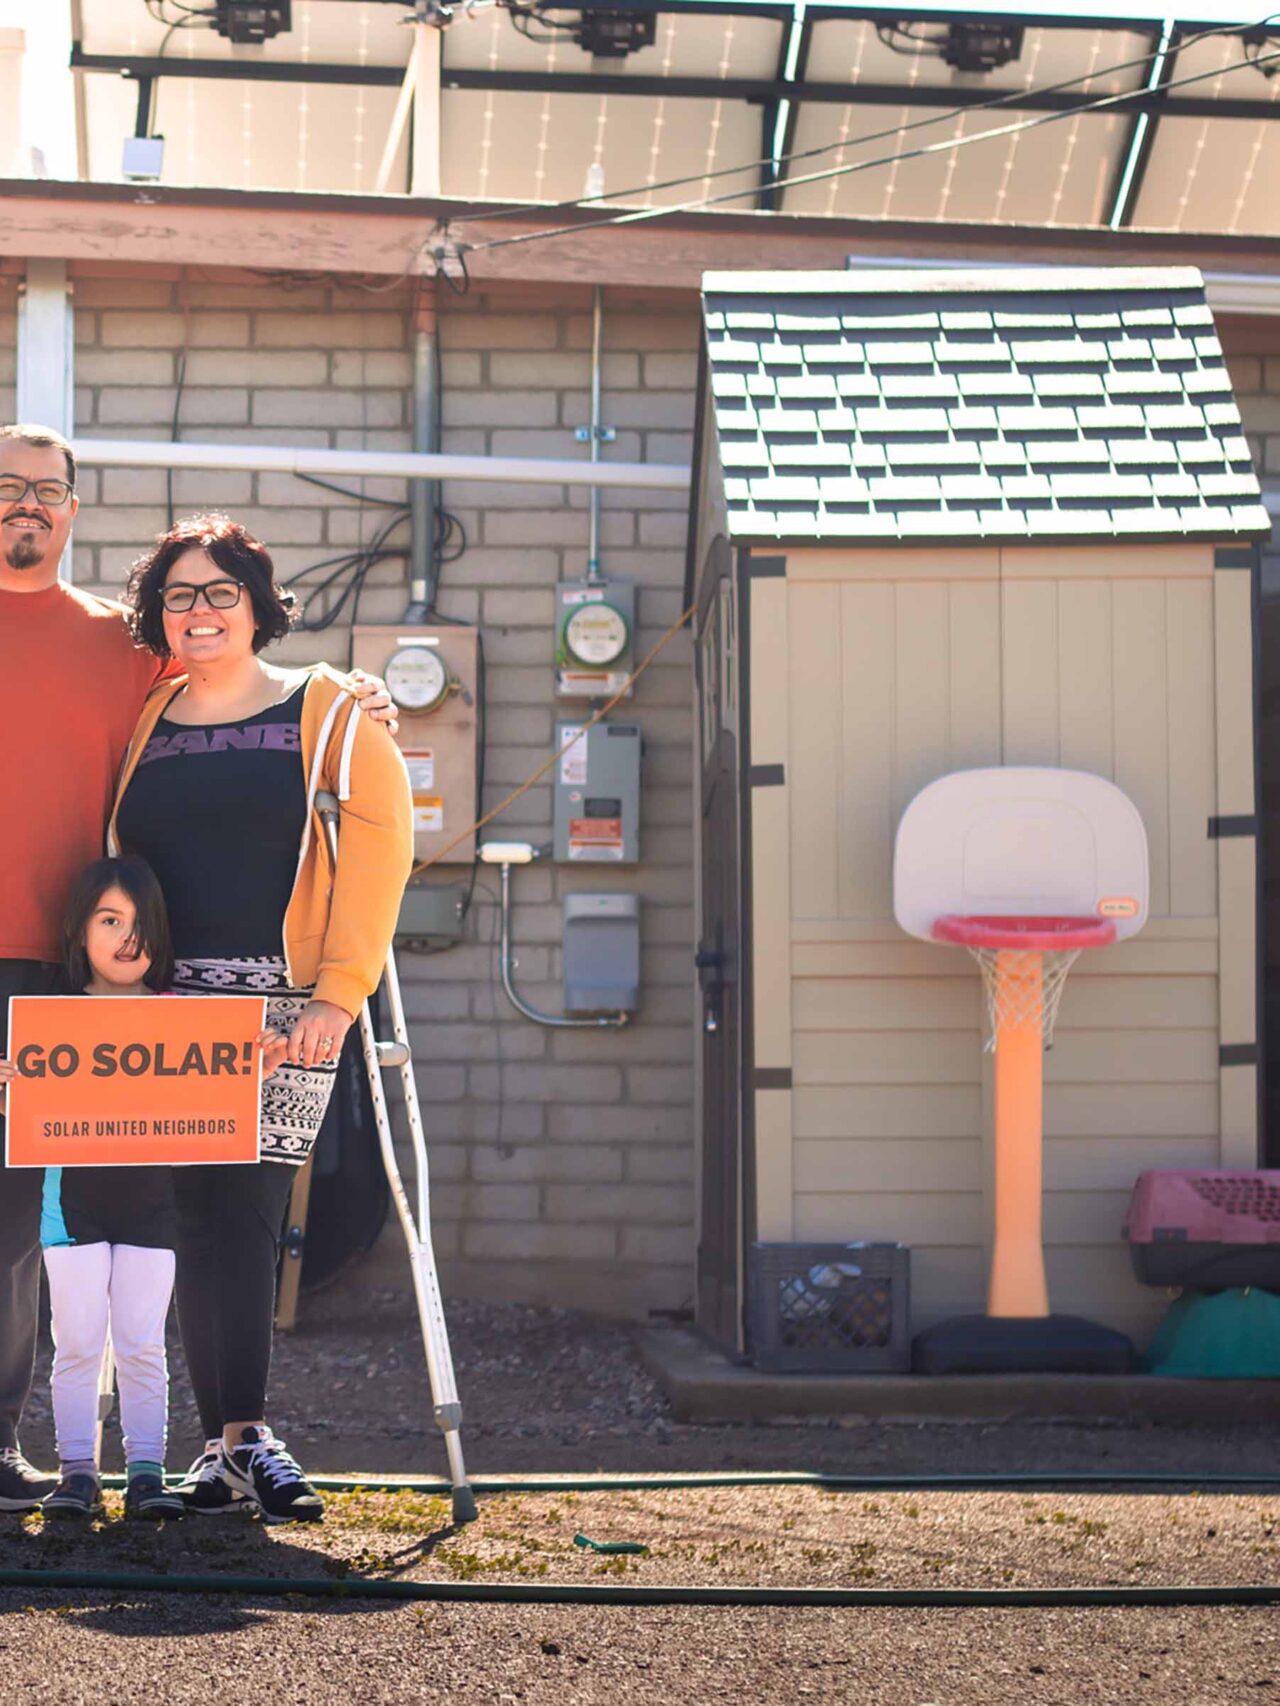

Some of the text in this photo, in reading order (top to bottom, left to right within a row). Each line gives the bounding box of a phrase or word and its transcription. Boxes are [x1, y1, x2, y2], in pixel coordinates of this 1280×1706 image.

[16, 1042, 254, 1078] GO SOLAR!
[43, 1119, 236, 1137] SOLAR UNITED NEIGHBORS
